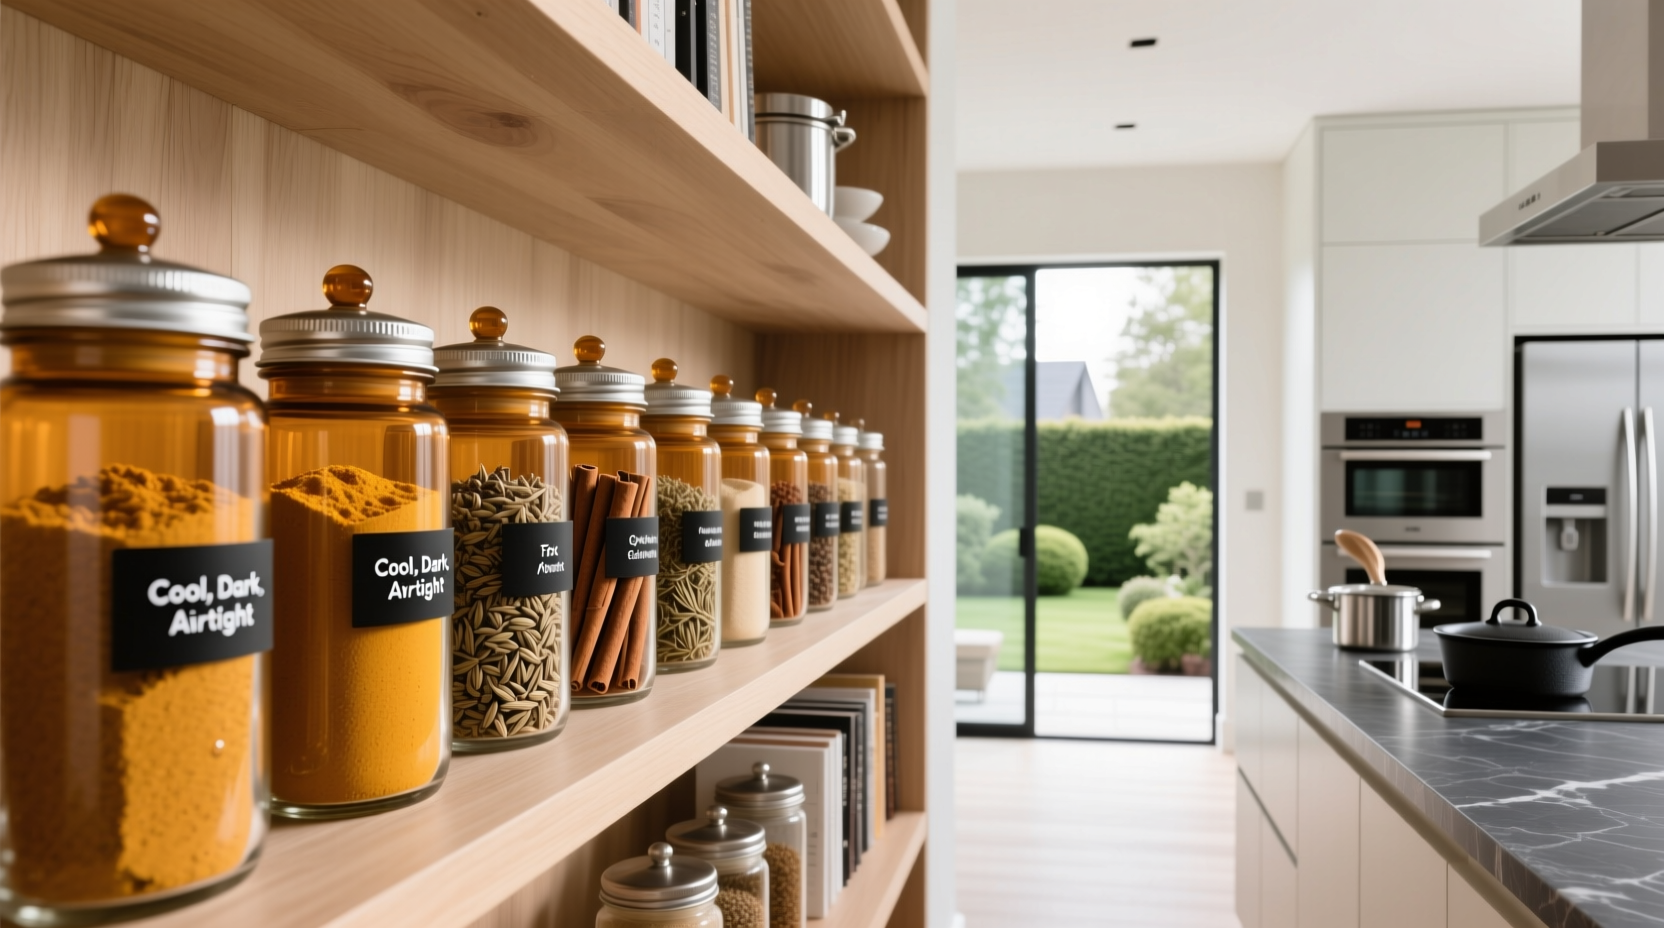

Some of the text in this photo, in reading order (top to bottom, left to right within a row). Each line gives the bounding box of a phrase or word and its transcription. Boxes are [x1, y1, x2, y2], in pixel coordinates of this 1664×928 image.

[374, 556, 419, 578] Cool,
[148, 571, 266, 607] Cool, Dark,
[168, 602, 256, 637] Airtight
